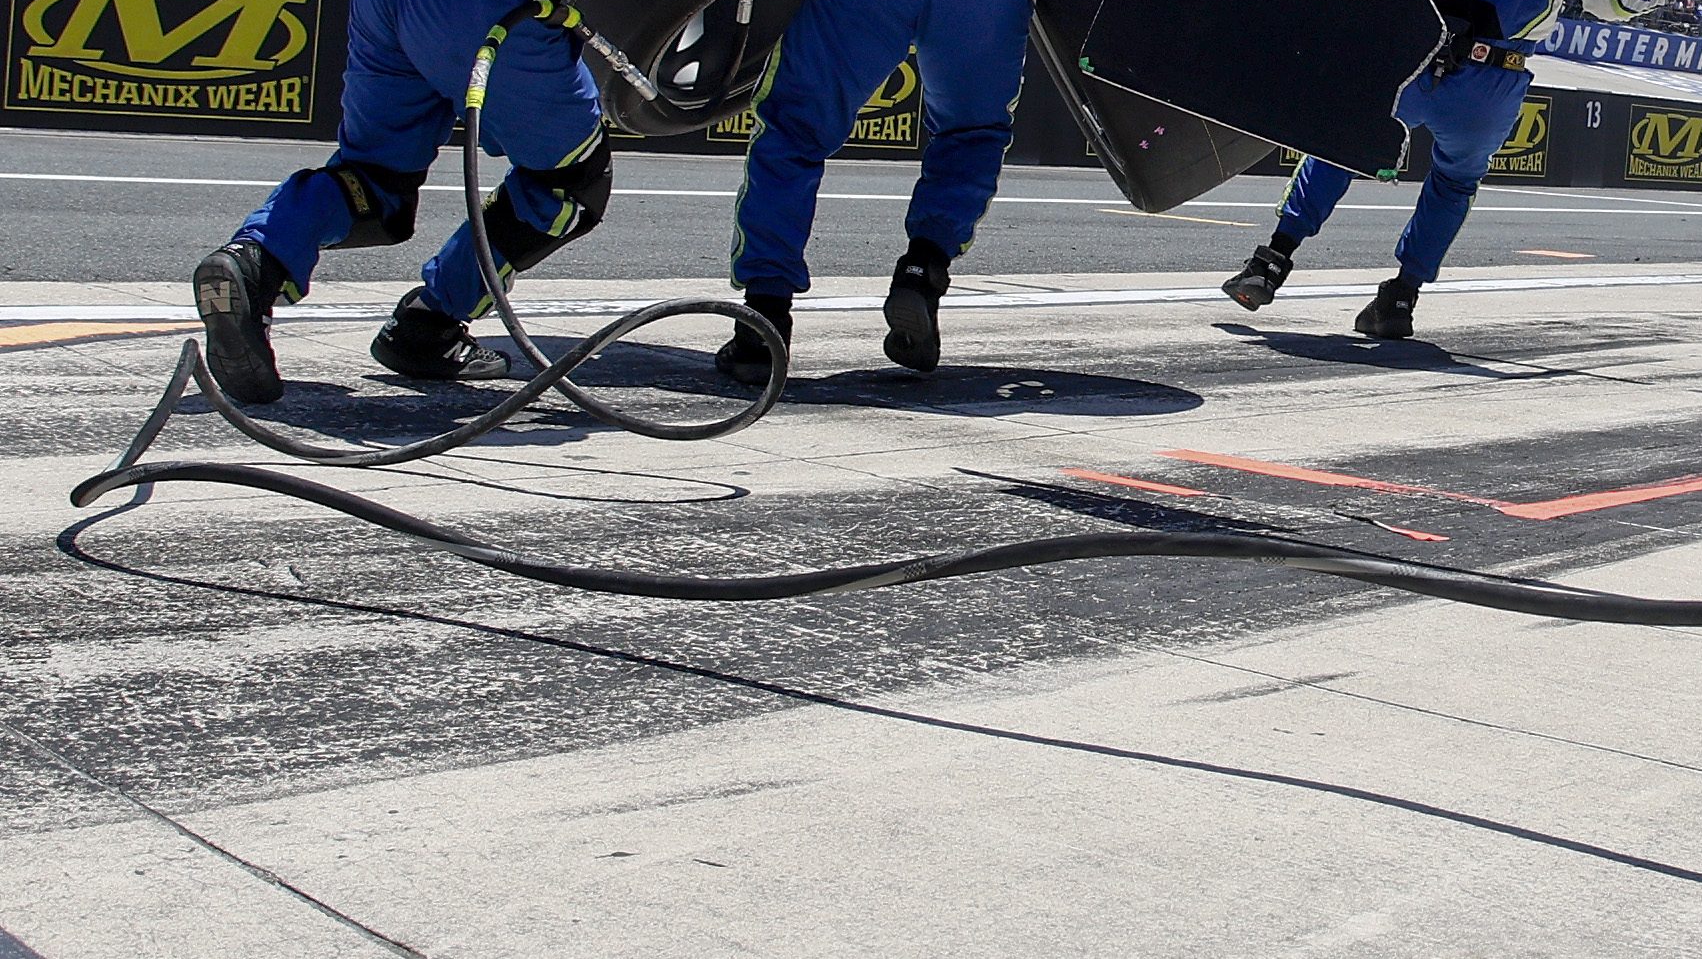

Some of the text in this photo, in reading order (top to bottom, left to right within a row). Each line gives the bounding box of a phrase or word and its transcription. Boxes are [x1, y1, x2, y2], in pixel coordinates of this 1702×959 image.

[1544, 21, 1669, 66] ONSTER
[18, 57, 302, 114] MECHANIX WEAR
[1586, 101, 1601, 129] 13
[1508, 154, 1544, 173] WEAR
[1629, 156, 1680, 179] MECHANIX
